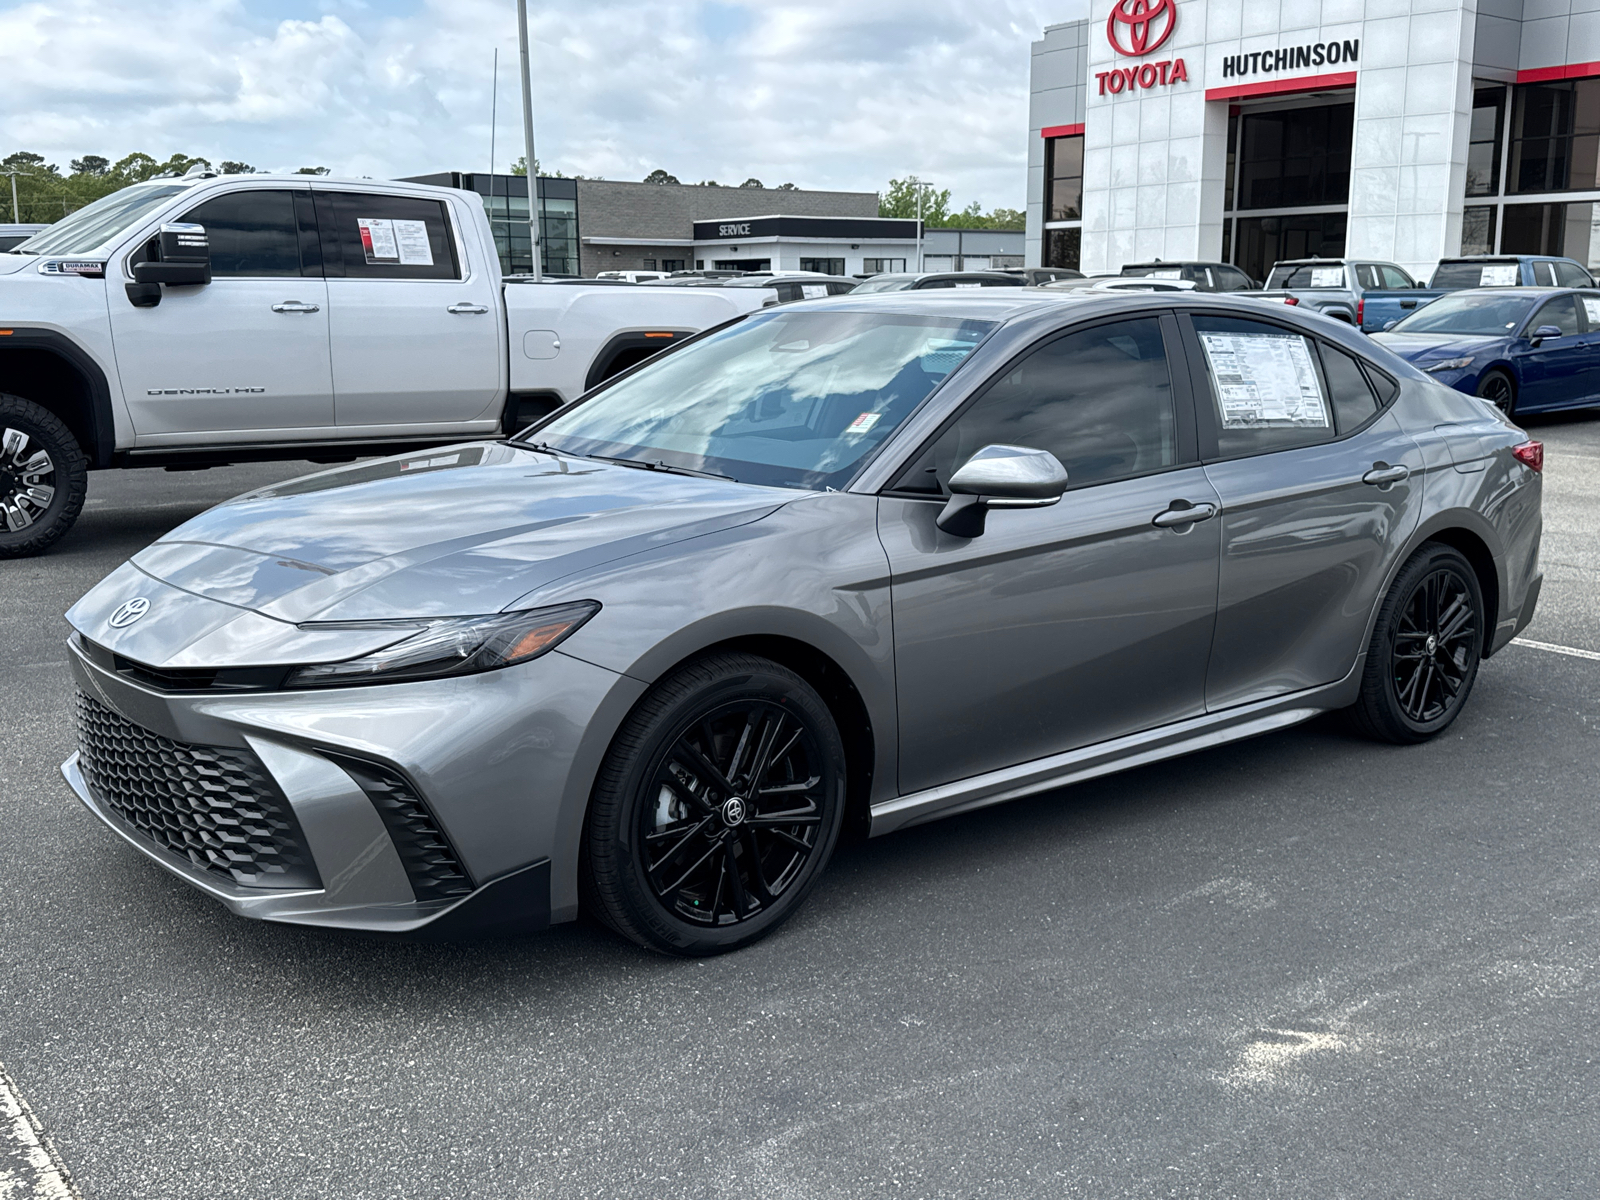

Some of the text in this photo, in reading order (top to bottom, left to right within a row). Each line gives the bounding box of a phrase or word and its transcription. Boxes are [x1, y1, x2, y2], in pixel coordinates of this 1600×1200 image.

[1223, 39, 1359, 78] HUTCHINSON
[1095, 58, 1188, 96] TOYOTA
[719, 223, 751, 236] SERVICE
[147, 387, 230, 396] DENALI
